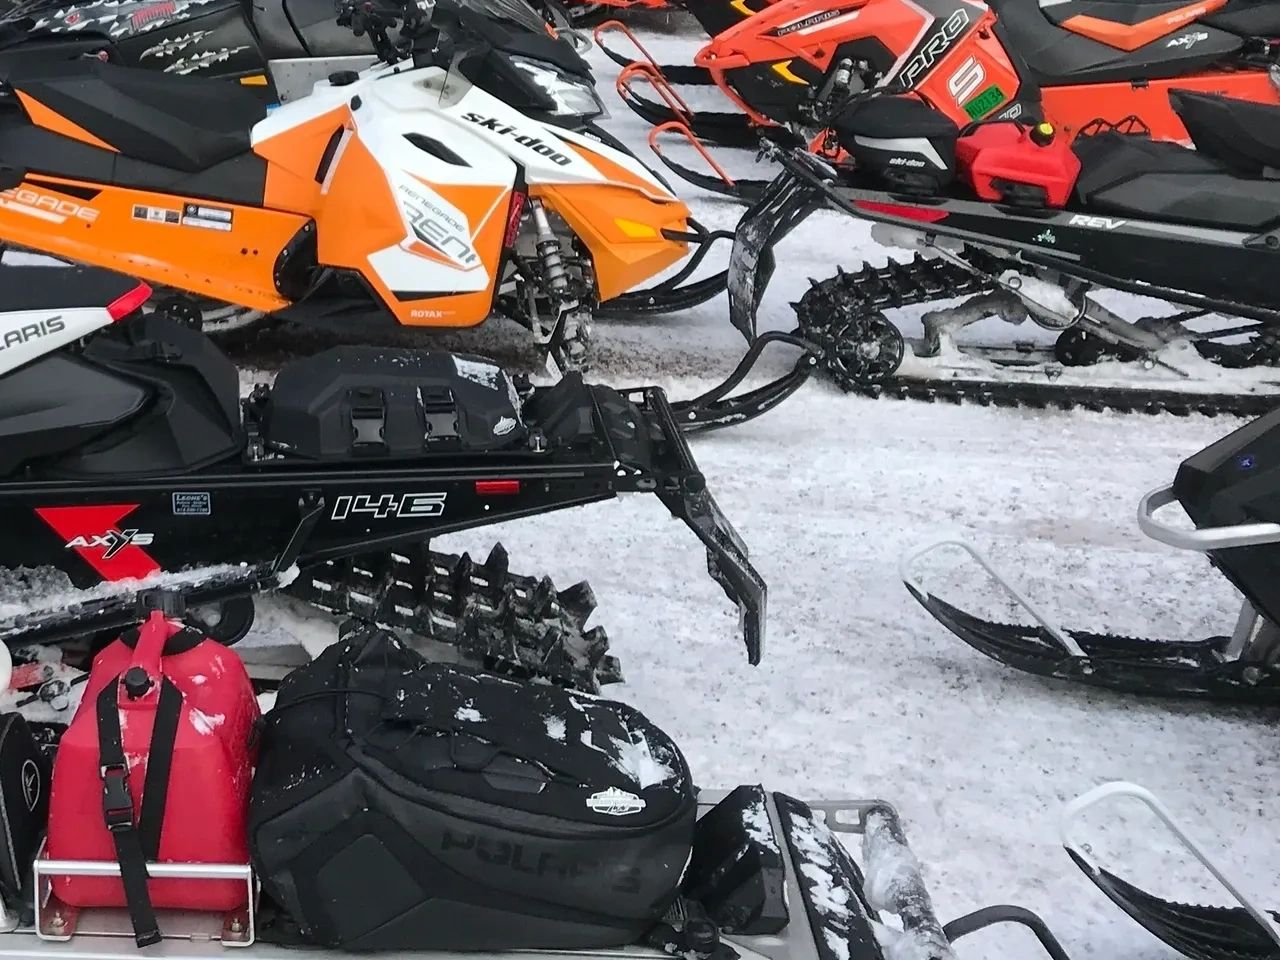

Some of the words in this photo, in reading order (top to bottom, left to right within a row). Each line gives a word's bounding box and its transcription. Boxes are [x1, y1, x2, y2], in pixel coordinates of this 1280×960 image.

[778, 9, 841, 36] POLARIS
[900, 8, 970, 88] PRO
[1166, 32, 1208, 49] AXYS
[461, 112, 572, 166] ski-doo
[889, 157, 926, 168] ski-doo
[398, 184, 466, 233] RENEGADE
[1069, 214, 1127, 229] REV
[411, 310, 443, 318] ROTAX
[331, 492, 447, 520] 146
[65, 529, 154, 560] AXYS
